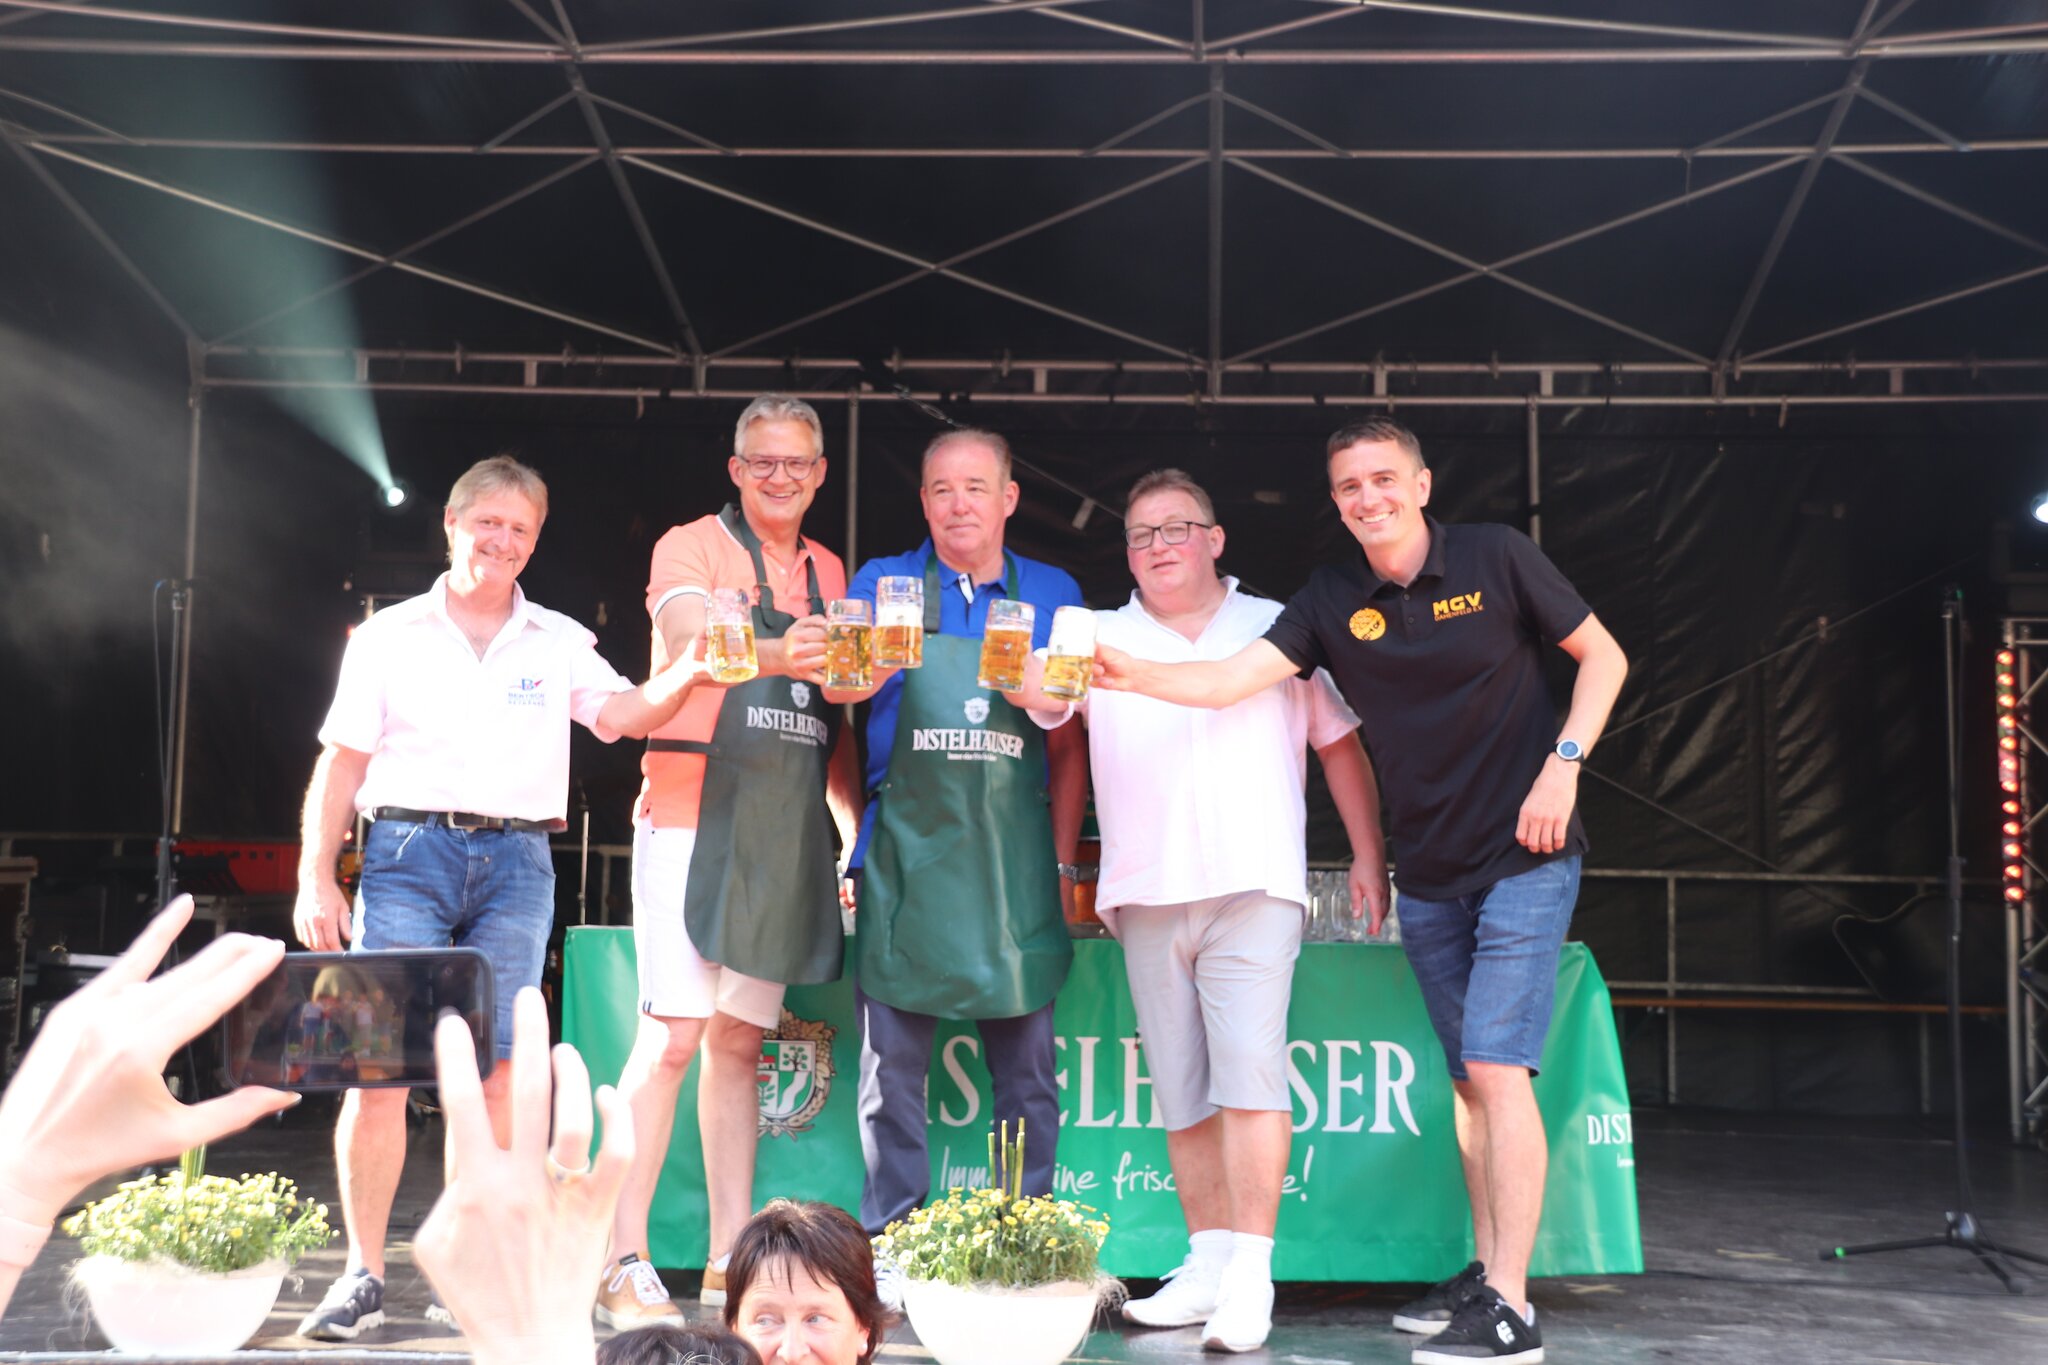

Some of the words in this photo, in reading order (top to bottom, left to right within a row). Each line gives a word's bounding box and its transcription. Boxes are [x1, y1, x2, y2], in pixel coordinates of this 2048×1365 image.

[1432, 591, 1482, 616] MGV
[912, 728, 1024, 760] DISTELHÄUSER
[940, 1146, 995, 1192] Imm
[1053, 1163, 1101, 1195] ine
[1112, 1151, 1179, 1201] frisc
